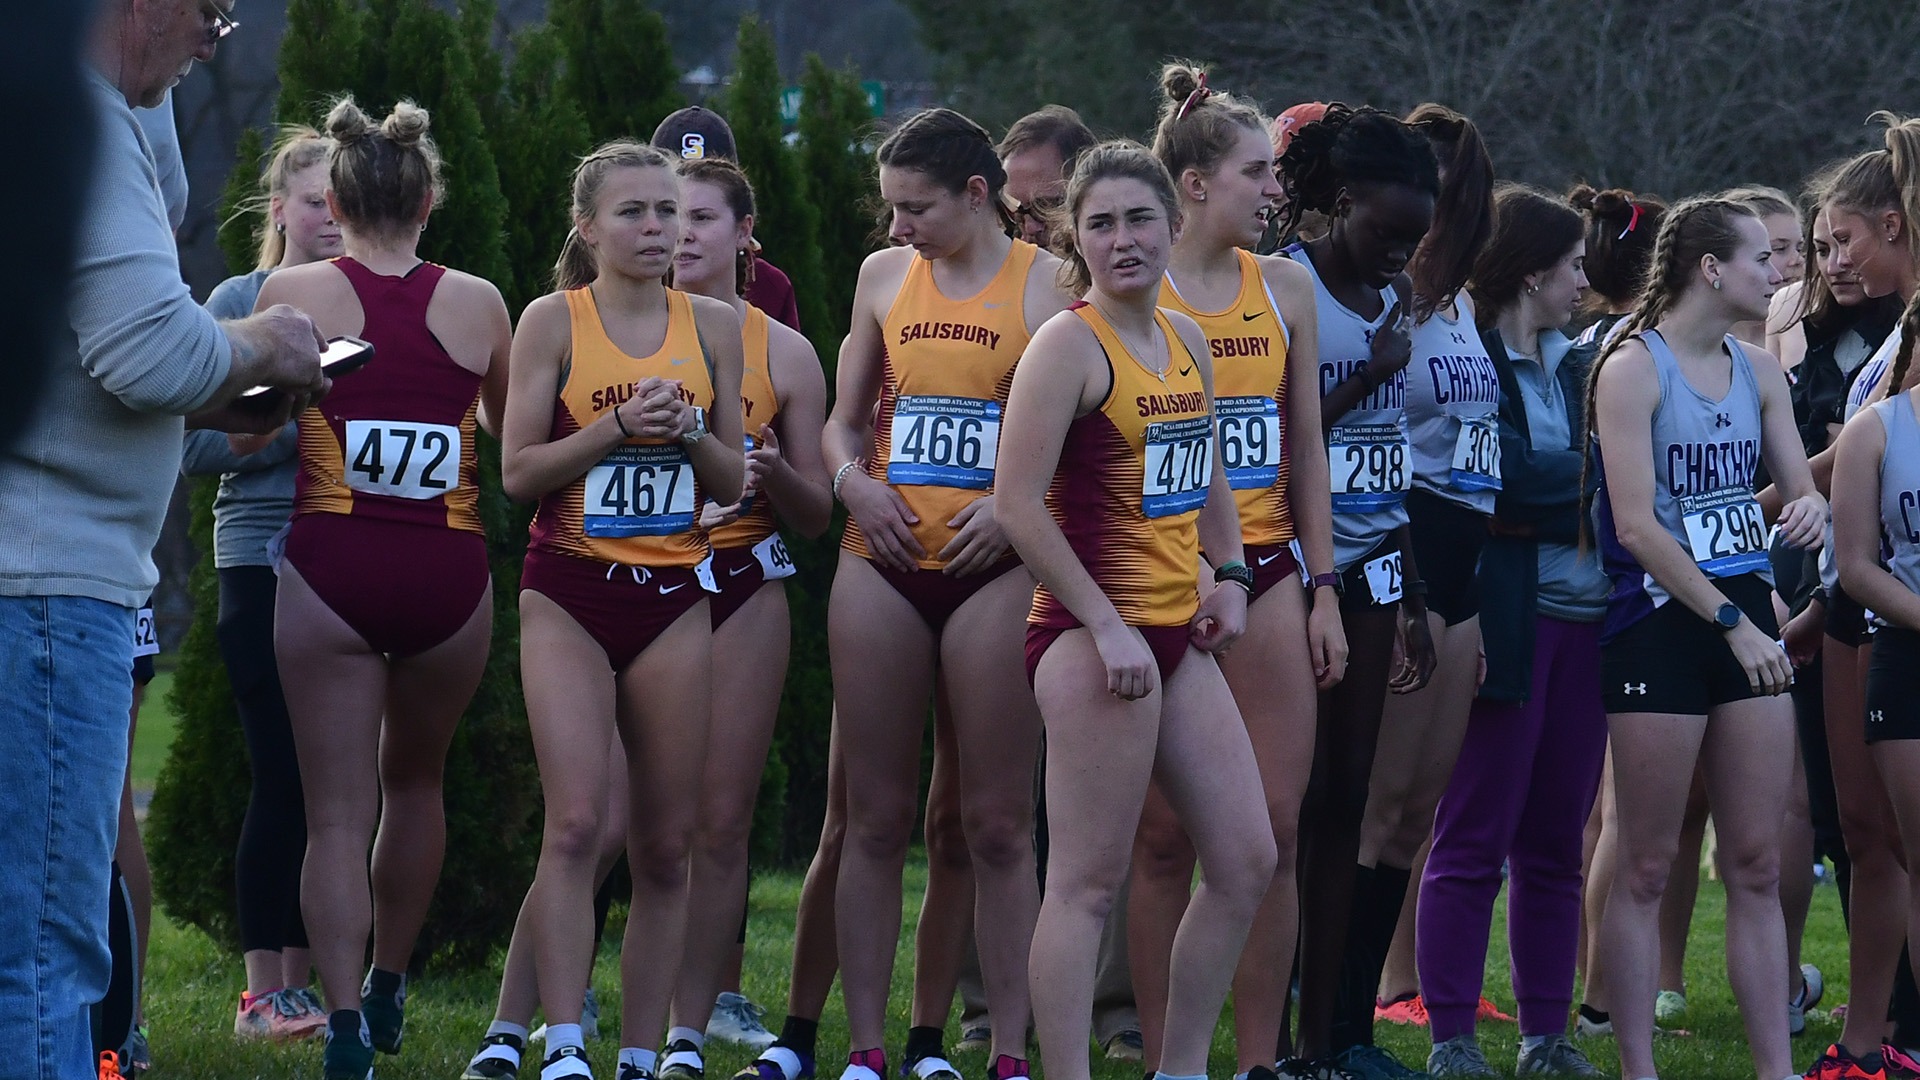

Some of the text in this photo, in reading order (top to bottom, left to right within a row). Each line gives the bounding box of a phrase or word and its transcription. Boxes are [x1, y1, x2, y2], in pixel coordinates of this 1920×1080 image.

[682, 133, 705, 159] S
[899, 321, 1001, 352] SALISBURY
[1206, 336, 1270, 358] SBURY
[936, 406, 985, 415] CHAMPIONSHIP
[951, 399, 984, 408] ATLANTIC
[1221, 406, 1265, 414] CHAMPIONSHIP
[352, 428, 450, 489] 472
[901, 414, 983, 470] 466
[1156, 437, 1207, 495] 470
[1346, 443, 1403, 494] 298
[601, 463, 682, 518] 467
[1701, 503, 1763, 560] 296
